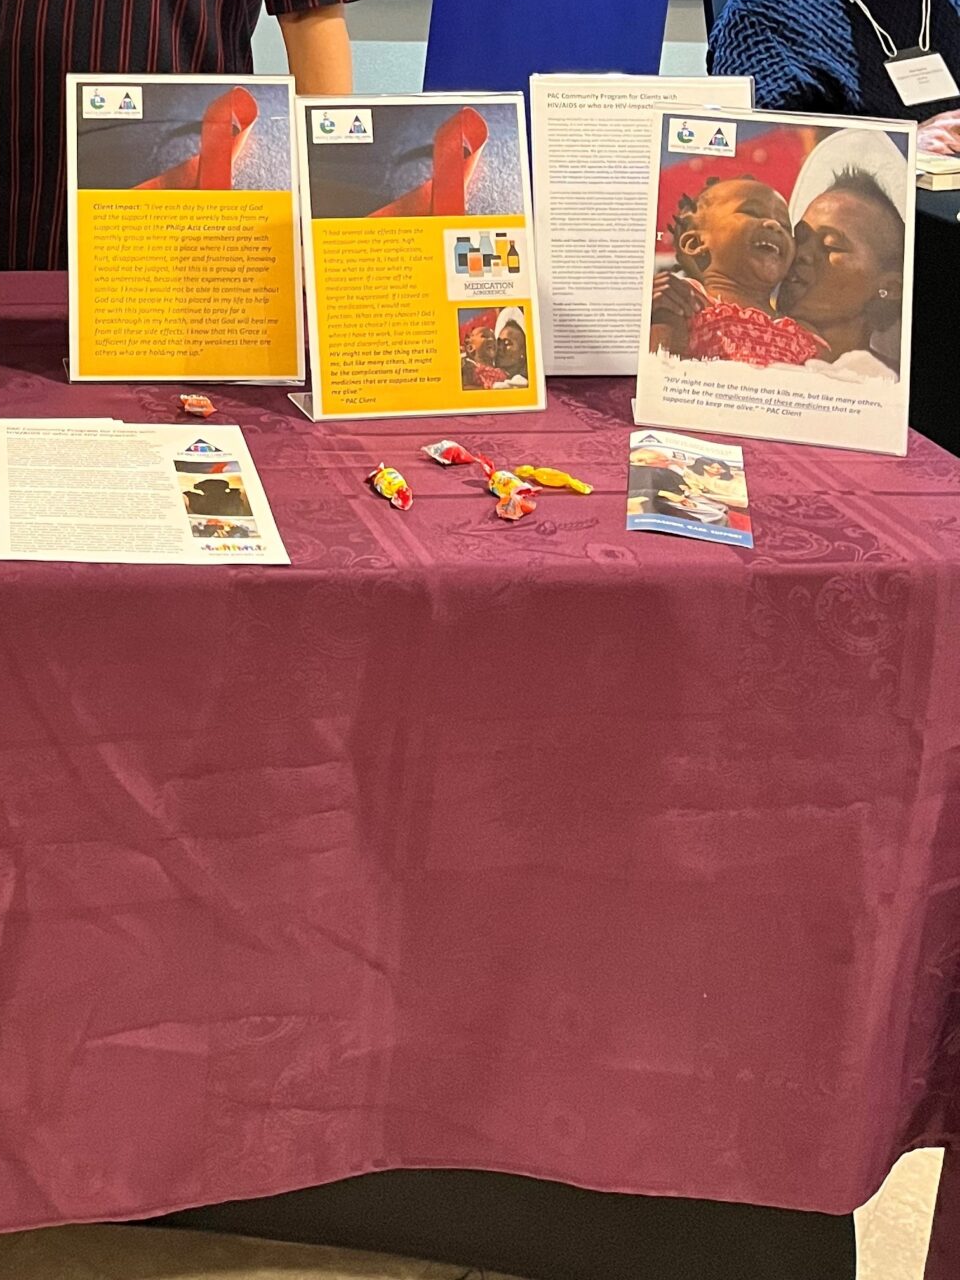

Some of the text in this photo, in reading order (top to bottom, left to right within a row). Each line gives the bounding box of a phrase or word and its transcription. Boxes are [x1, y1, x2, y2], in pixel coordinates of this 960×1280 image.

[562, 93, 599, 101] Community
[600, 93, 628, 101] Program
[166, 224, 186, 232] Philip
[464, 281, 514, 290] MEDICATION
[681, 376, 701, 388] might
[704, 379, 715, 387] not
[717, 380, 725, 388] be
[727, 381, 738, 390] the
[741, 383, 759, 394] thing
[761, 385, 775, 394] that
[777, 387, 791, 396] kills
[808, 391, 820, 400] but
[822, 393, 834, 402] like
[836, 397, 856, 406] many
[346, 396, 357, 404] PAC
[670, 385, 690, 397] might
[702, 388, 713, 397] the
[715, 390, 764, 405] complications
[774, 397, 793, 407] these
[794, 399, 830, 411] medicines
[832, 404, 847, 413] that
[663, 394, 696, 407] supposed
[706, 398, 722, 410] keep
[766, 405, 780, 414] PAC
[782, 407, 801, 417] Client
